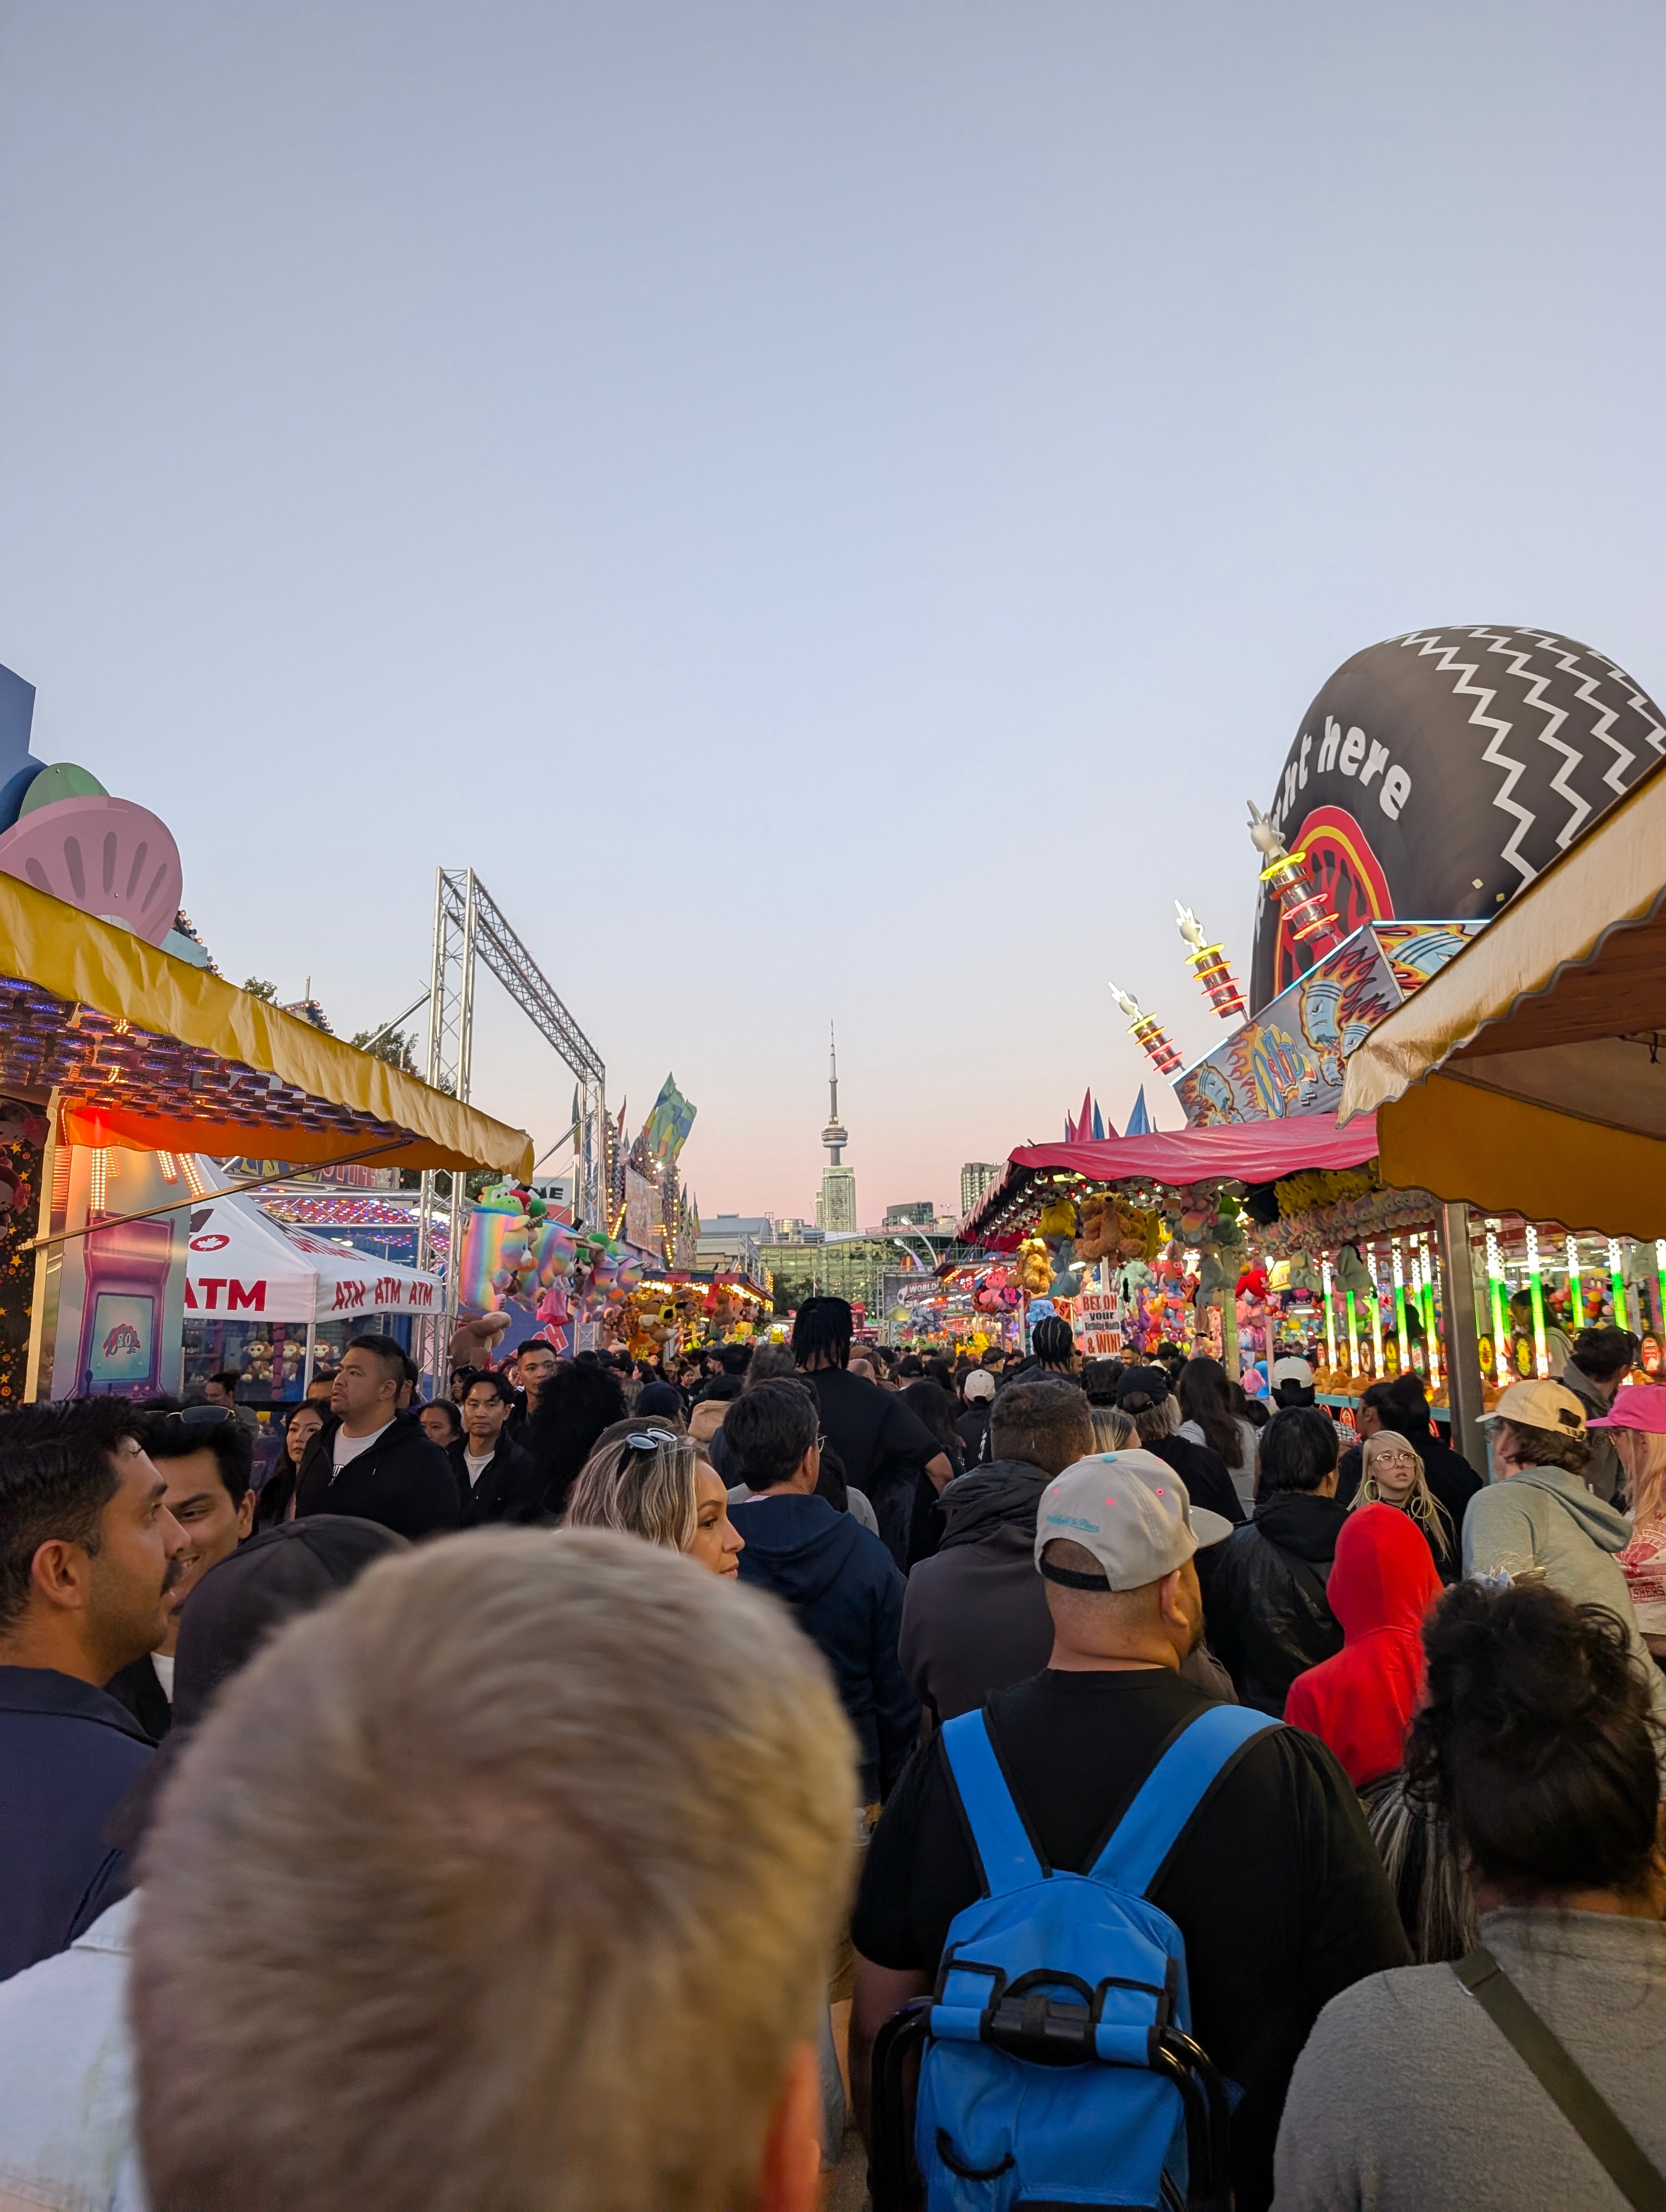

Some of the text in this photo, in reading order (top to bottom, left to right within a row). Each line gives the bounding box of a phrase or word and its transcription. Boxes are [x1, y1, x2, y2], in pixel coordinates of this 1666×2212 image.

[1317, 715, 1411, 820] here
[331, 1277, 433, 1311] ATM ATM ATM
[909, 1283, 939, 1293] WORLD
[1083, 1295, 1100, 1310] BET
[1104, 1294, 1117, 1310] ON
[1090, 1312, 1114, 1321] your
[1088, 1334, 1121, 1354] & WIN!
